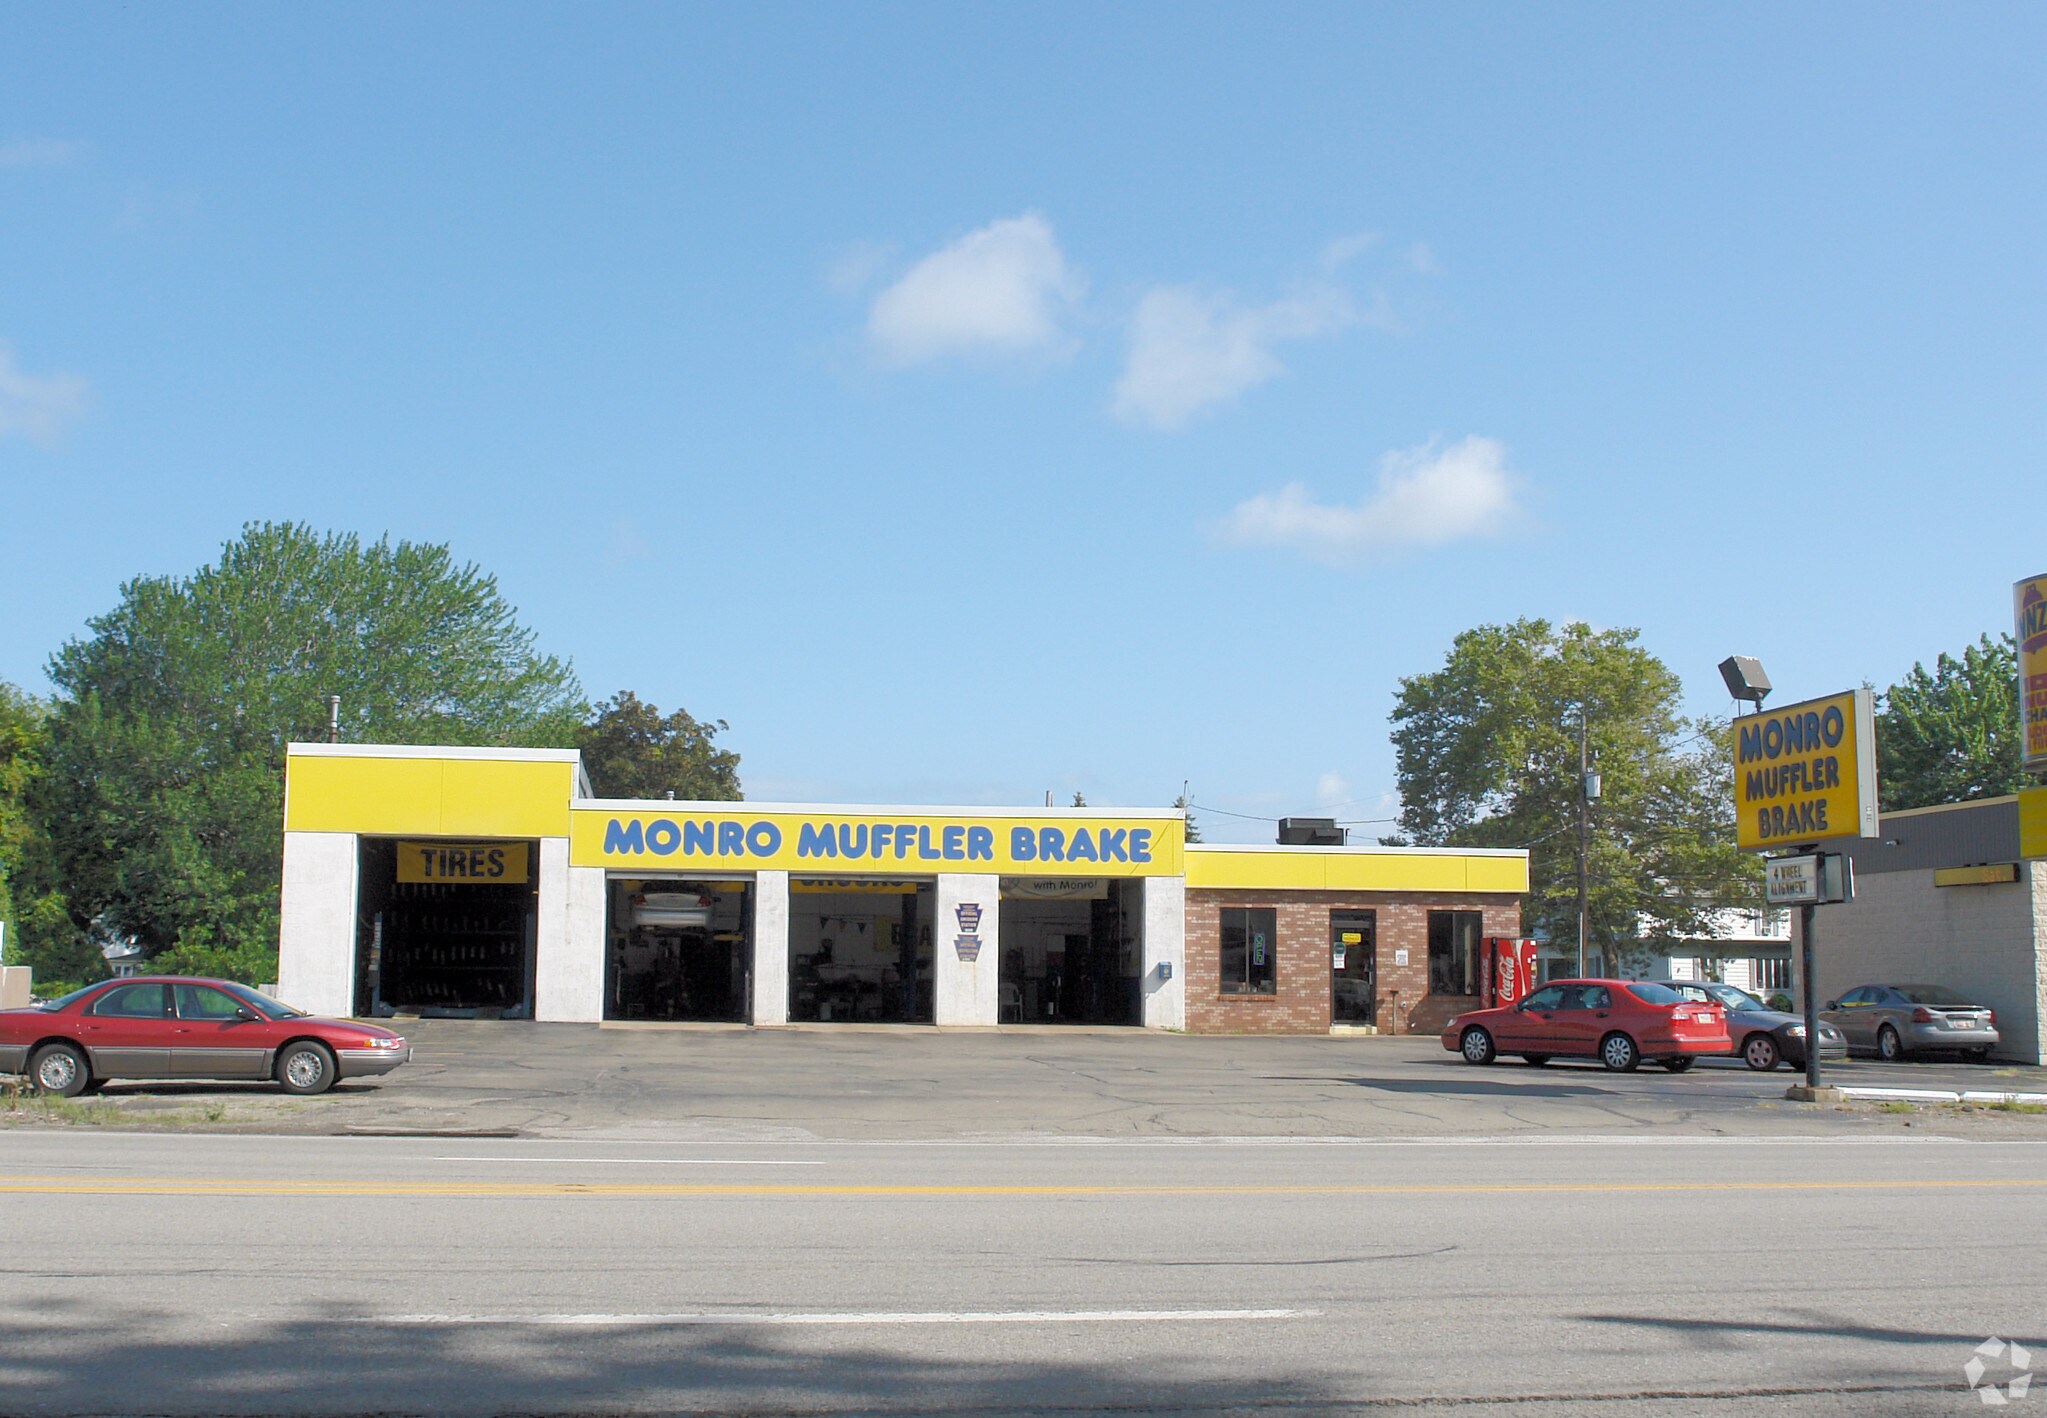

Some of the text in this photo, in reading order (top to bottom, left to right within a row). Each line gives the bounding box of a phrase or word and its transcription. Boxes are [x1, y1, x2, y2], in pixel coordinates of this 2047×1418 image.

[1739, 706, 1844, 764] MONRO
[1745, 756, 1840, 802] MUFFLER
[1758, 798, 1828, 838] BRAKE
[420, 849, 505, 877] TIRES
[603, 819, 1152, 863] MONRO MUFFLER BRAKE
[1033, 880, 1097, 890] with Monro!
[1498, 955, 1515, 1001] Coca-Cola
